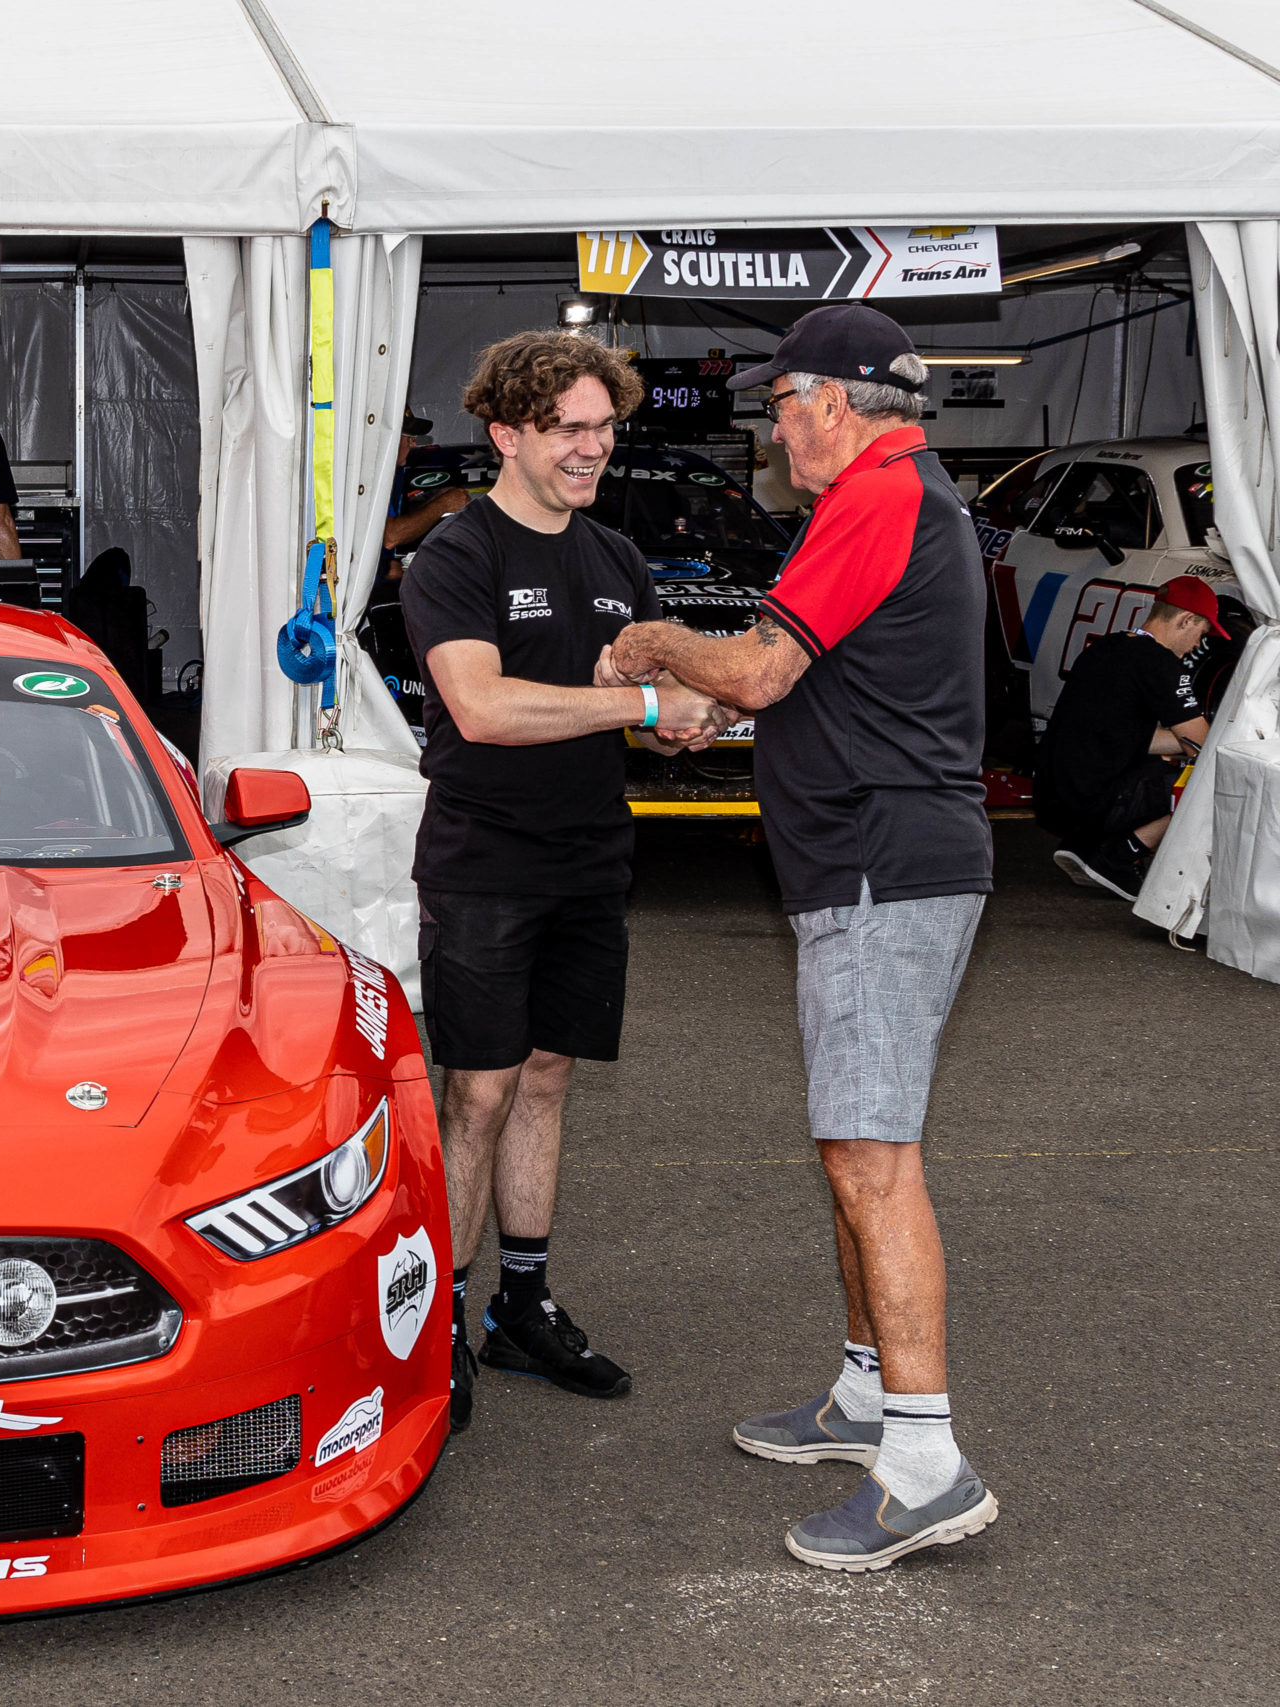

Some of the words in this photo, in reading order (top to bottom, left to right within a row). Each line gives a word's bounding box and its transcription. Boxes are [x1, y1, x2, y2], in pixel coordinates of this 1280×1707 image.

[661, 230, 716, 246] CRAIG
[908, 242, 978, 253] CHEVROLET
[662, 250, 810, 287] SCUTELLA
[901, 267, 949, 282] Trans
[951, 265, 987, 280] Am
[652, 387, 688, 408] 9:40
[509, 588, 547, 606] TCR
[509, 609, 552, 621] S5000
[594, 598, 632, 617] GRM
[354, 979, 389, 1060] JAMES
[319, 1412, 381, 1462] motorsport
